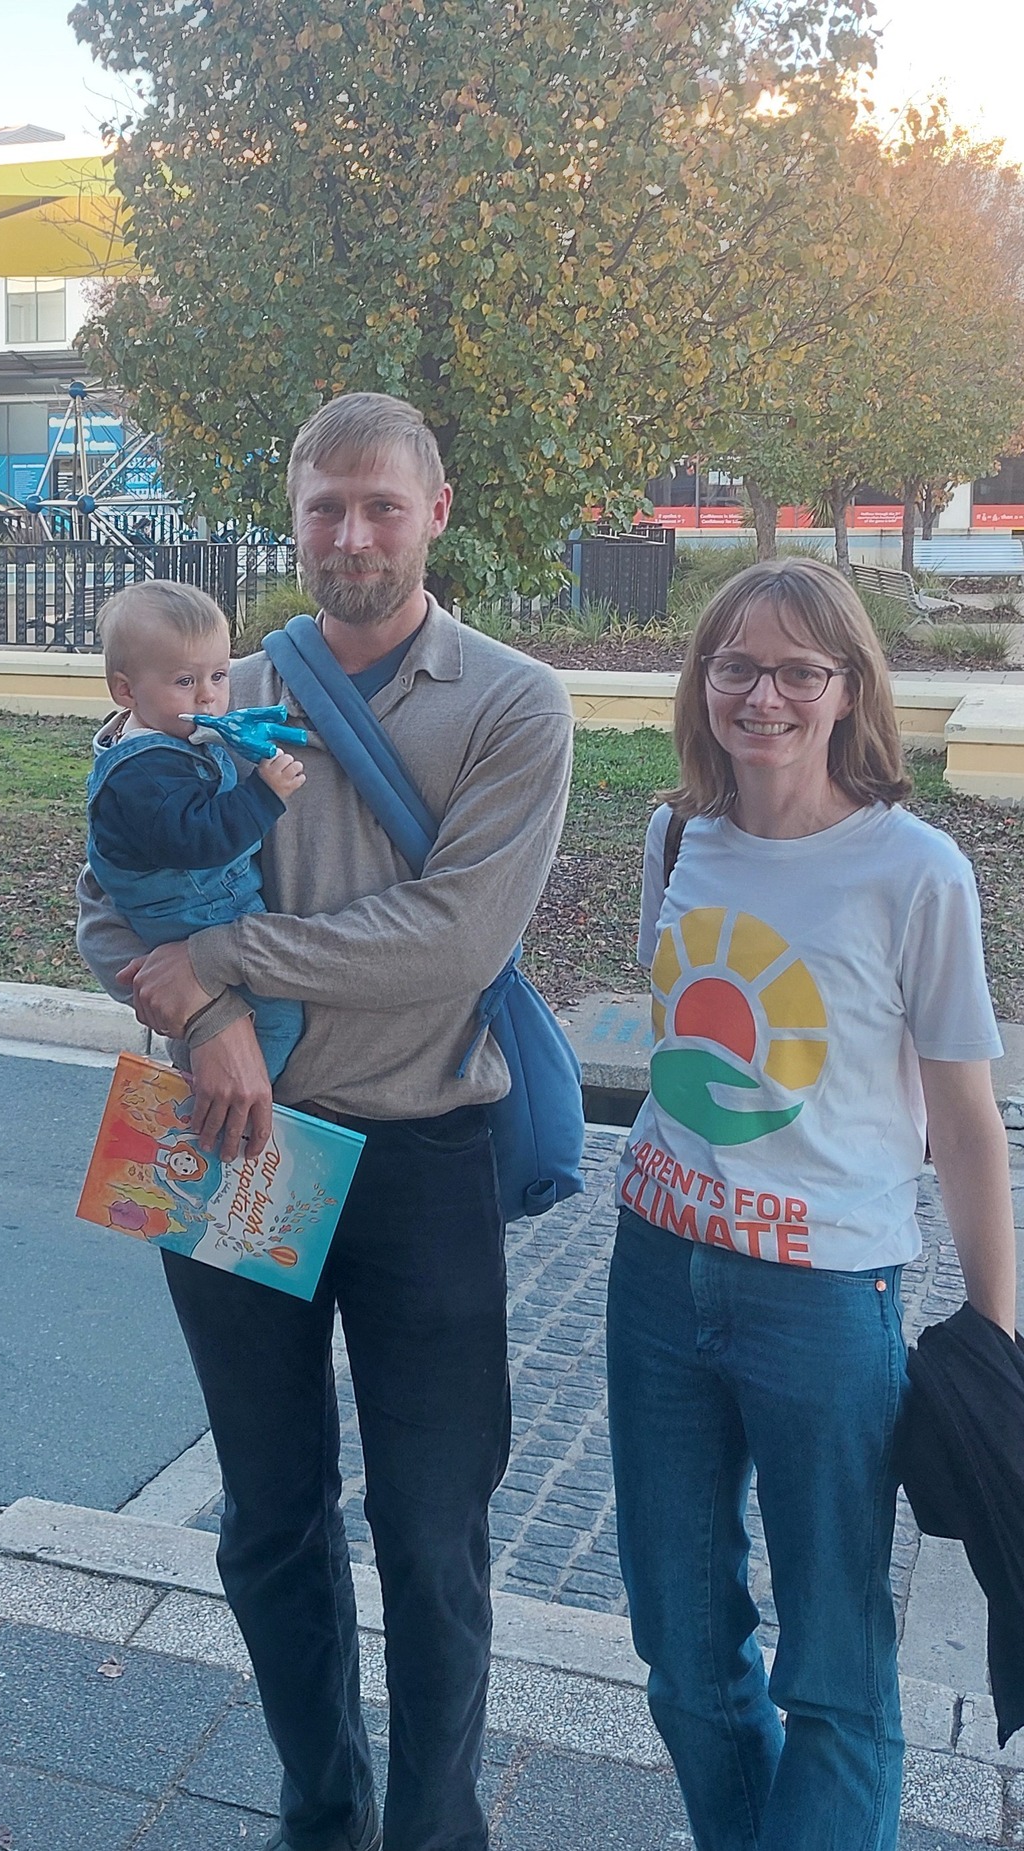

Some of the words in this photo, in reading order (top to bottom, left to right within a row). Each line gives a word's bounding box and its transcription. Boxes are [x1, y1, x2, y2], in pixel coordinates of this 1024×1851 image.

[227, 1156, 259, 1232] capital
[261, 1138, 280, 1200] our
[243, 1189, 274, 1240] bush
[621, 1163, 812, 1268] CLIMATE
[734, 1187, 807, 1223] FOR
